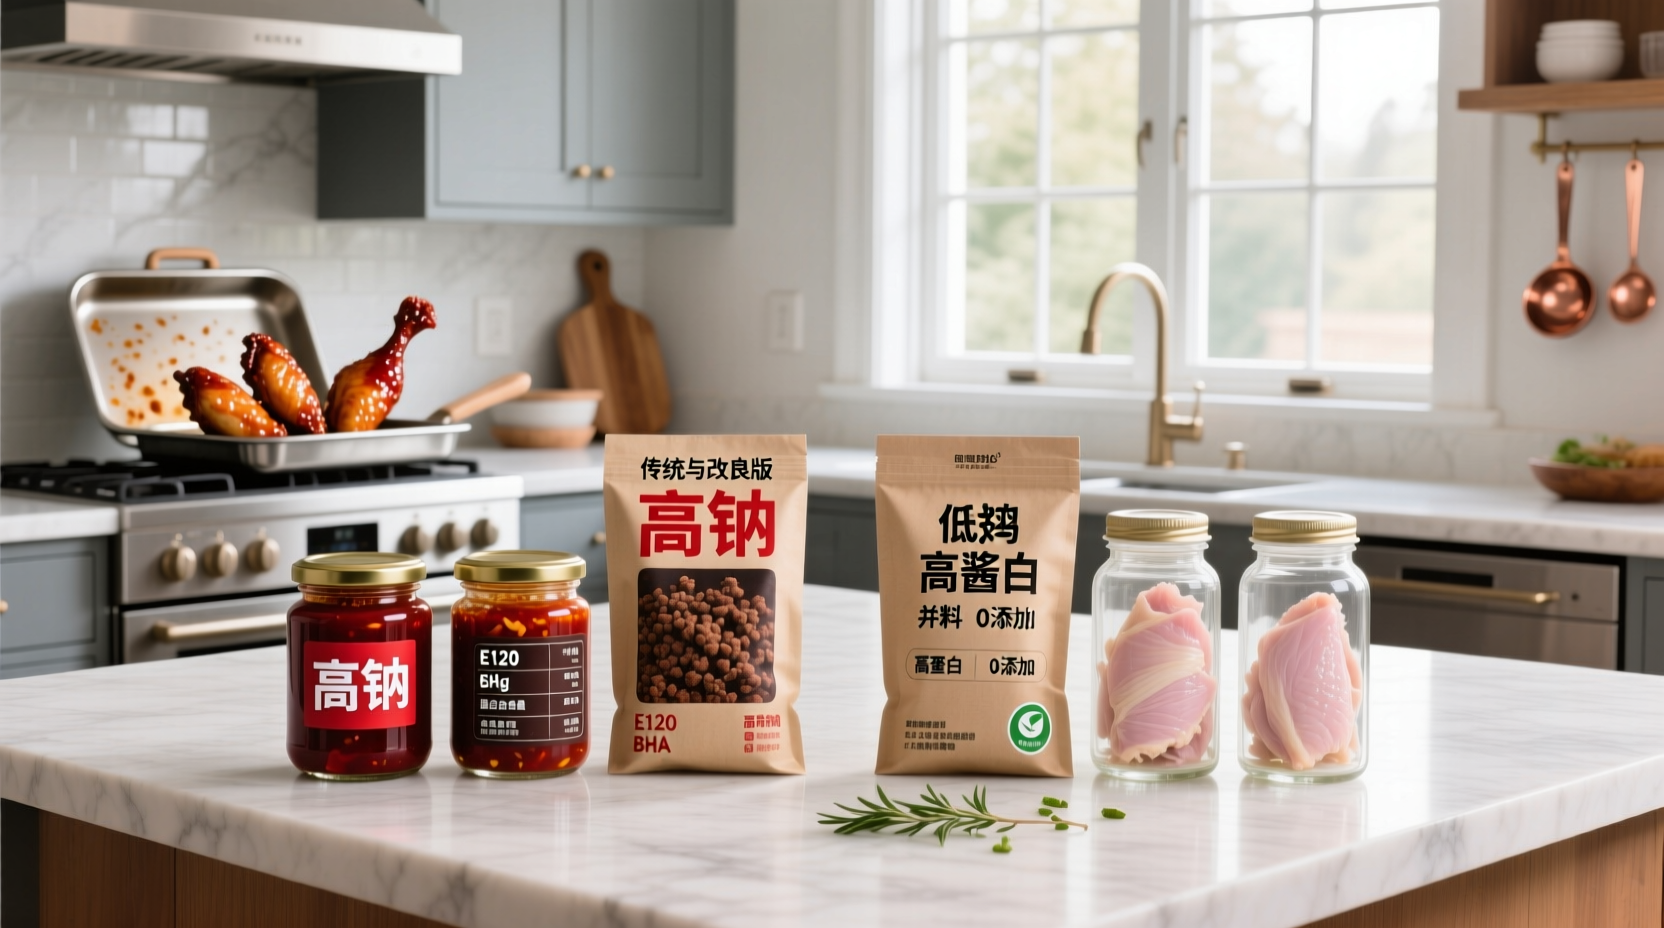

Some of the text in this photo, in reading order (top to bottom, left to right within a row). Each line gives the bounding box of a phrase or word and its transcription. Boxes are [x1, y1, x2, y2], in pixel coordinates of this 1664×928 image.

[640, 456, 773, 481] 传统与改良版
[639, 488, 775, 558] 高钠
[920, 550, 1038, 595] 高酱白
[480, 649, 520, 667] E120
[989, 656, 1035, 676] 0添加
[313, 656, 409, 712] 高钠
[634, 713, 677, 732] E120
[633, 735, 672, 753] BHA
